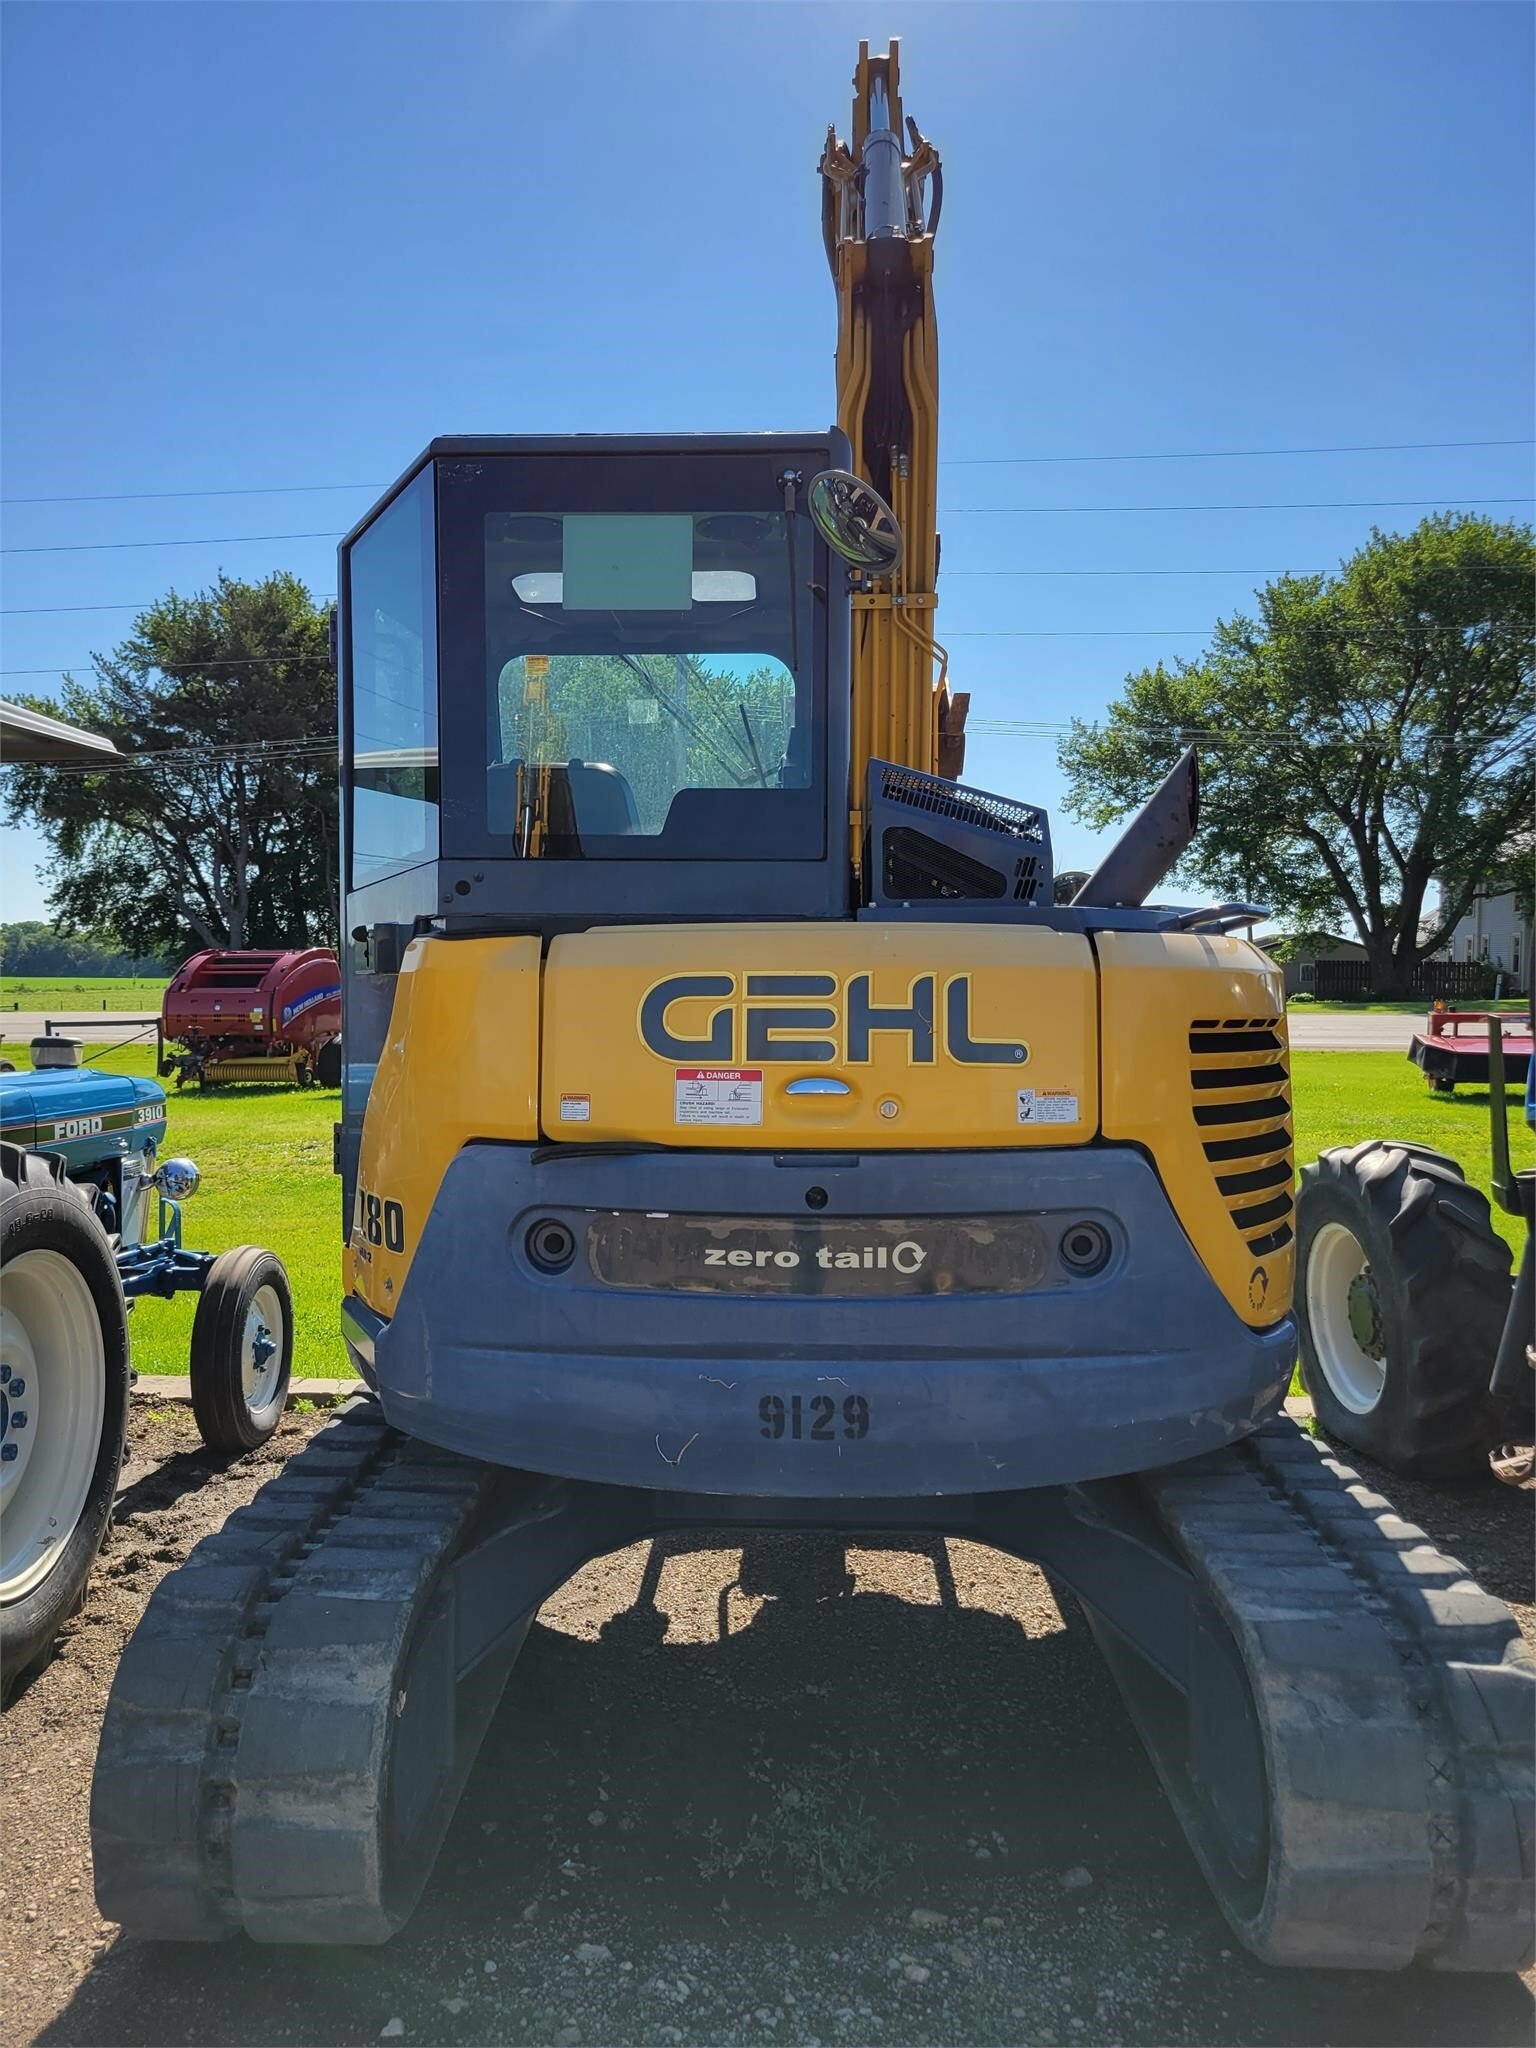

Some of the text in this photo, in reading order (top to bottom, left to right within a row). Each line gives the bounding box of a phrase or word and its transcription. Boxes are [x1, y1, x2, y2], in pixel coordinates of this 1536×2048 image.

[638, 972, 1030, 1065] GEHL
[706, 1072, 741, 1080] DANGER
[138, 1105, 163, 1123] 3910
[54, 1117, 102, 1141] FORD
[704, 1246, 887, 1269] zero tail
[758, 1394, 870, 1441] 9129
